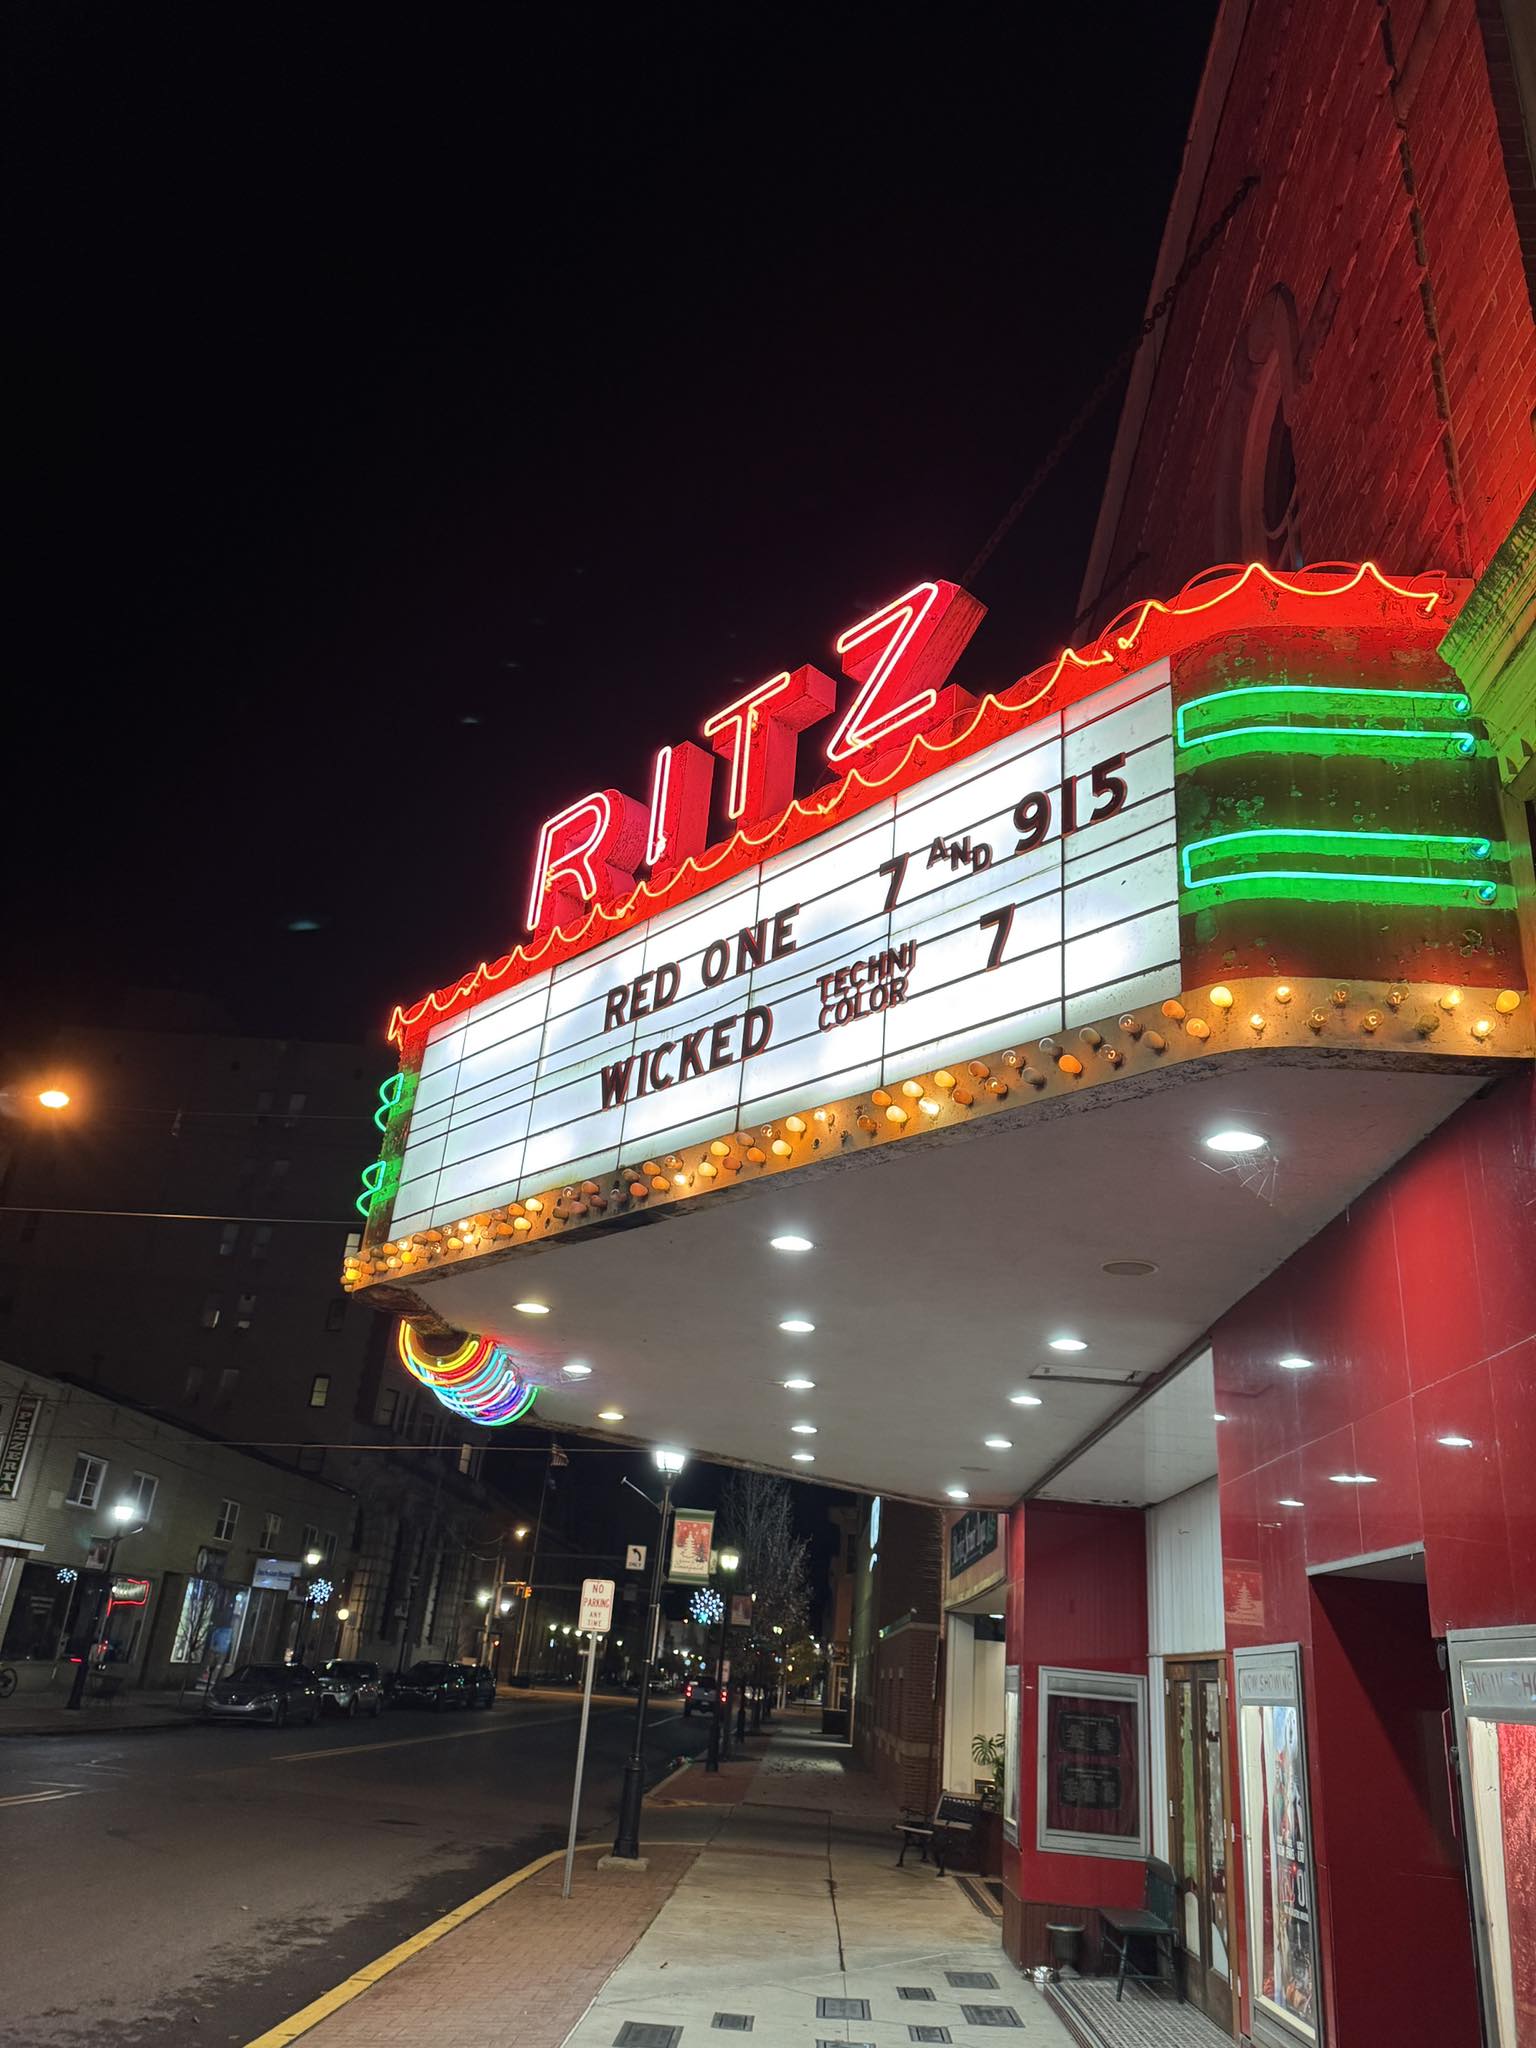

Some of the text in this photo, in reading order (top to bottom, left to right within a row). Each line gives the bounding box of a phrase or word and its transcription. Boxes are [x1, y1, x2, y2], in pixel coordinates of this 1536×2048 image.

[527, 578, 962, 935] RITZ
[603, 961, 682, 1034] RED
[701, 902, 801, 989] ONE
[878, 851, 910, 913] 7
[925, 833, 994, 876] AND
[979, 902, 1016, 973] 7
[815, 938, 918, 1004] TECHNI
[818, 976, 910, 1033] COLOR
[600, 1004, 774, 1113] WICKED
[0, 1410, 33, 1493] PIZZERIA
[583, 1597, 610, 1609] PARKING
[592, 1583, 605, 1594] NO
[587, 1619, 602, 1627] TIME
[1471, 1671, 1504, 1699] NOW
